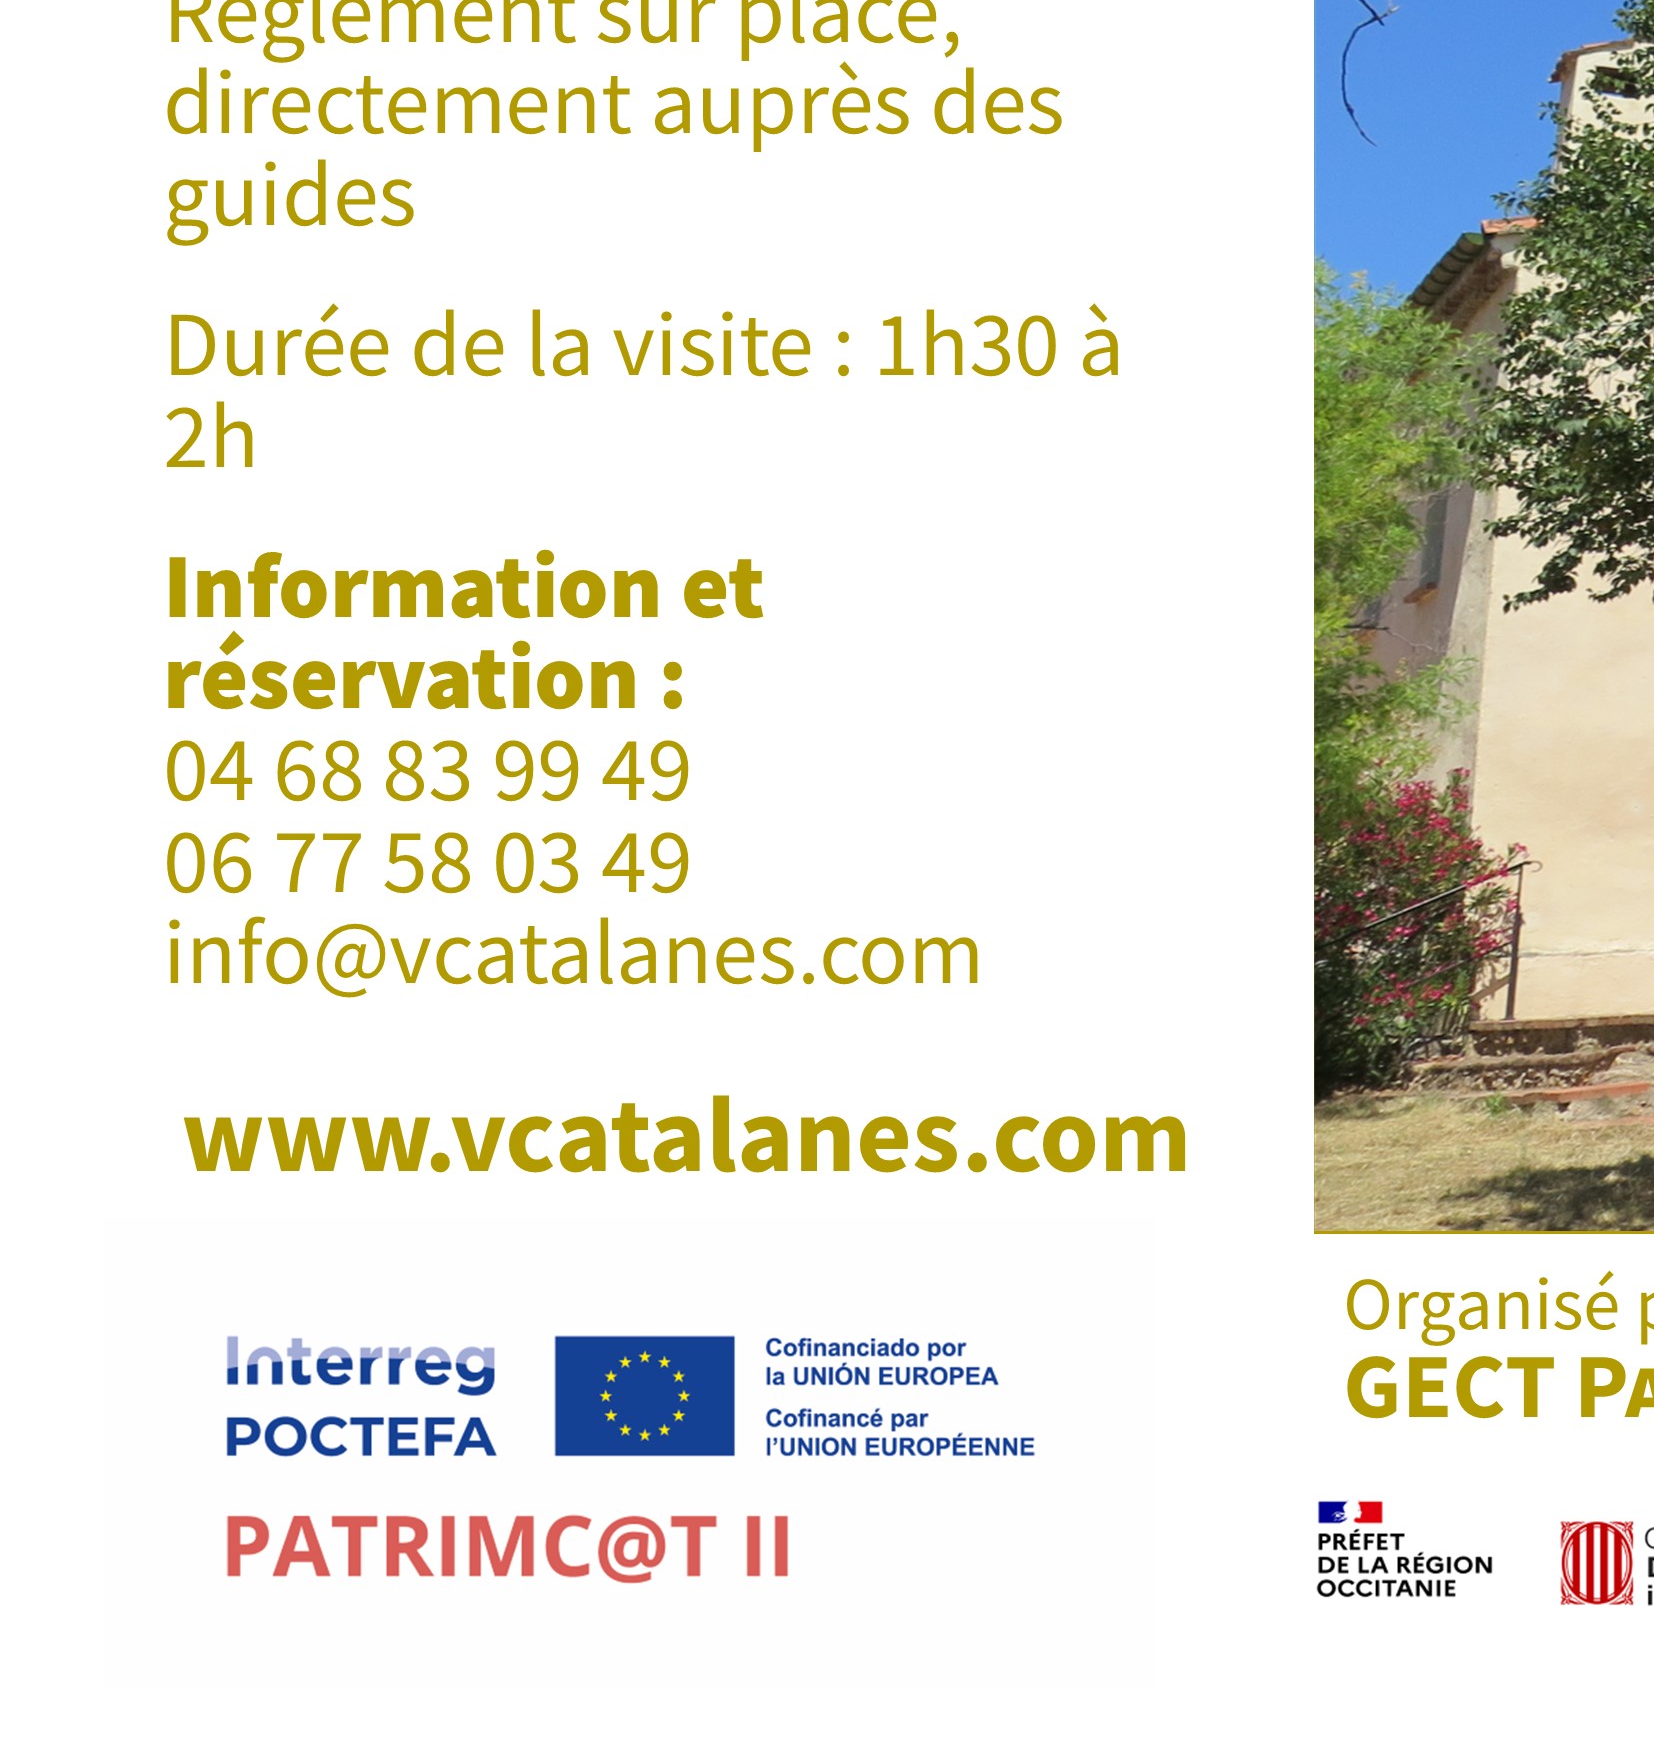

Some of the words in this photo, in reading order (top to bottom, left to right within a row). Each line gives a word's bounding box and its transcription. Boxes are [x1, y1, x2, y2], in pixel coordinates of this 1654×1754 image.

[167, 67, 631, 135] directement
[654, 61, 909, 152] auprès
[934, 67, 1062, 135] des
[167, 159, 414, 246] guides
[171, 303, 389, 377] Durée
[414, 309, 504, 377] de
[532, 309, 588, 377] la
[613, 311, 811, 377] visite
[880, 309, 1056, 377] 1h30
[1082, 303, 1118, 377] à
[166, 401, 253, 468] 2h
[169, 549, 658, 619] Information
[684, 559, 764, 619] et
[168, 631, 635, 710] réservation
[167, 740, 253, 802] 04
[277, 740, 361, 802] 68
[386, 740, 470, 802] 83
[495, 740, 579, 802] 99
[602, 740, 689, 802] 49
[167, 832, 252, 894] 06
[277, 833, 361, 892] 77
[384, 832, 470, 894] 58
[496, 832, 578, 894] 03
[602, 832, 689, 894] 49
[169, 916, 978, 998] info@vcatalanes.com
[184, 1095, 1186, 1173] www.vcatalanes.com
[1347, 1271, 1618, 1346] Organisé
[226, 1336, 495, 1396] Interreg
[766, 1338, 919, 1356] Cofinanciado
[928, 1343, 966, 1361] por
[767, 1367, 784, 1385] la
[794, 1363, 869, 1385] UNIÓN
[879, 1367, 998, 1385] EUROPEA
[1347, 1356, 1554, 1419] GECT
[227, 1416, 497, 1457] POCTEFA
[766, 1408, 883, 1427] Cofinancé
[892, 1413, 928, 1431] par
[767, 1437, 856, 1456] l’UNION
[866, 1433, 1034, 1456] EUROPÉENNE
[227, 1515, 717, 1583] PATRIMC@T
[747, 1516, 788, 1577] II
[1318, 1557, 1349, 1573] DE
[1359, 1557, 1388, 1573] LA
[1397, 1552, 1492, 1574] RÉGION
[1319, 1529, 1405, 1550] PRÉFET
[1317, 1579, 1455, 1597] OCCITANIE
[1648, 1585, 1652, 1605] i
